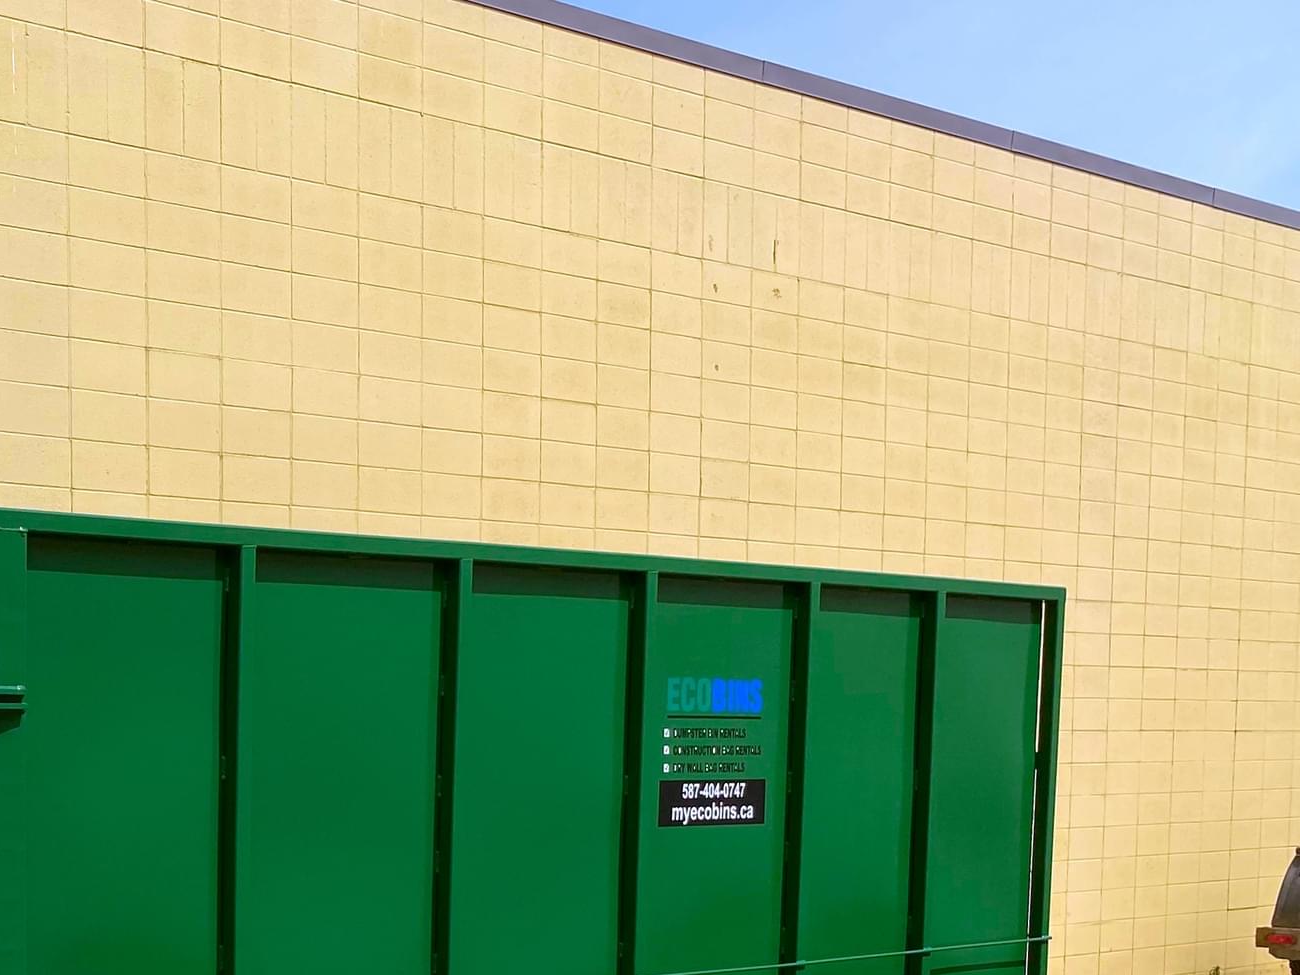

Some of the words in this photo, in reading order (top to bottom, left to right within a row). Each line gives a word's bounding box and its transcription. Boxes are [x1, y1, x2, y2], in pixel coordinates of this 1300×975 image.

[667, 677, 763, 713] ECOBINS
[673, 728, 706, 738] DUMPSTER
[707, 728, 719, 738] BIN
[719, 728, 746, 738] RENTALS
[673, 745, 721, 755] CONSTRUCTION
[722, 745, 734, 755] BAG
[735, 745, 761, 755] RENTALS
[673, 763, 686, 773] DRY
[687, 763, 703, 773] WALL
[705, 763, 717, 773] BAG
[718, 763, 745, 773] RENTALS
[682, 782, 746, 799] 587-404-0747
[671, 802, 754, 825] myecobins.ca
